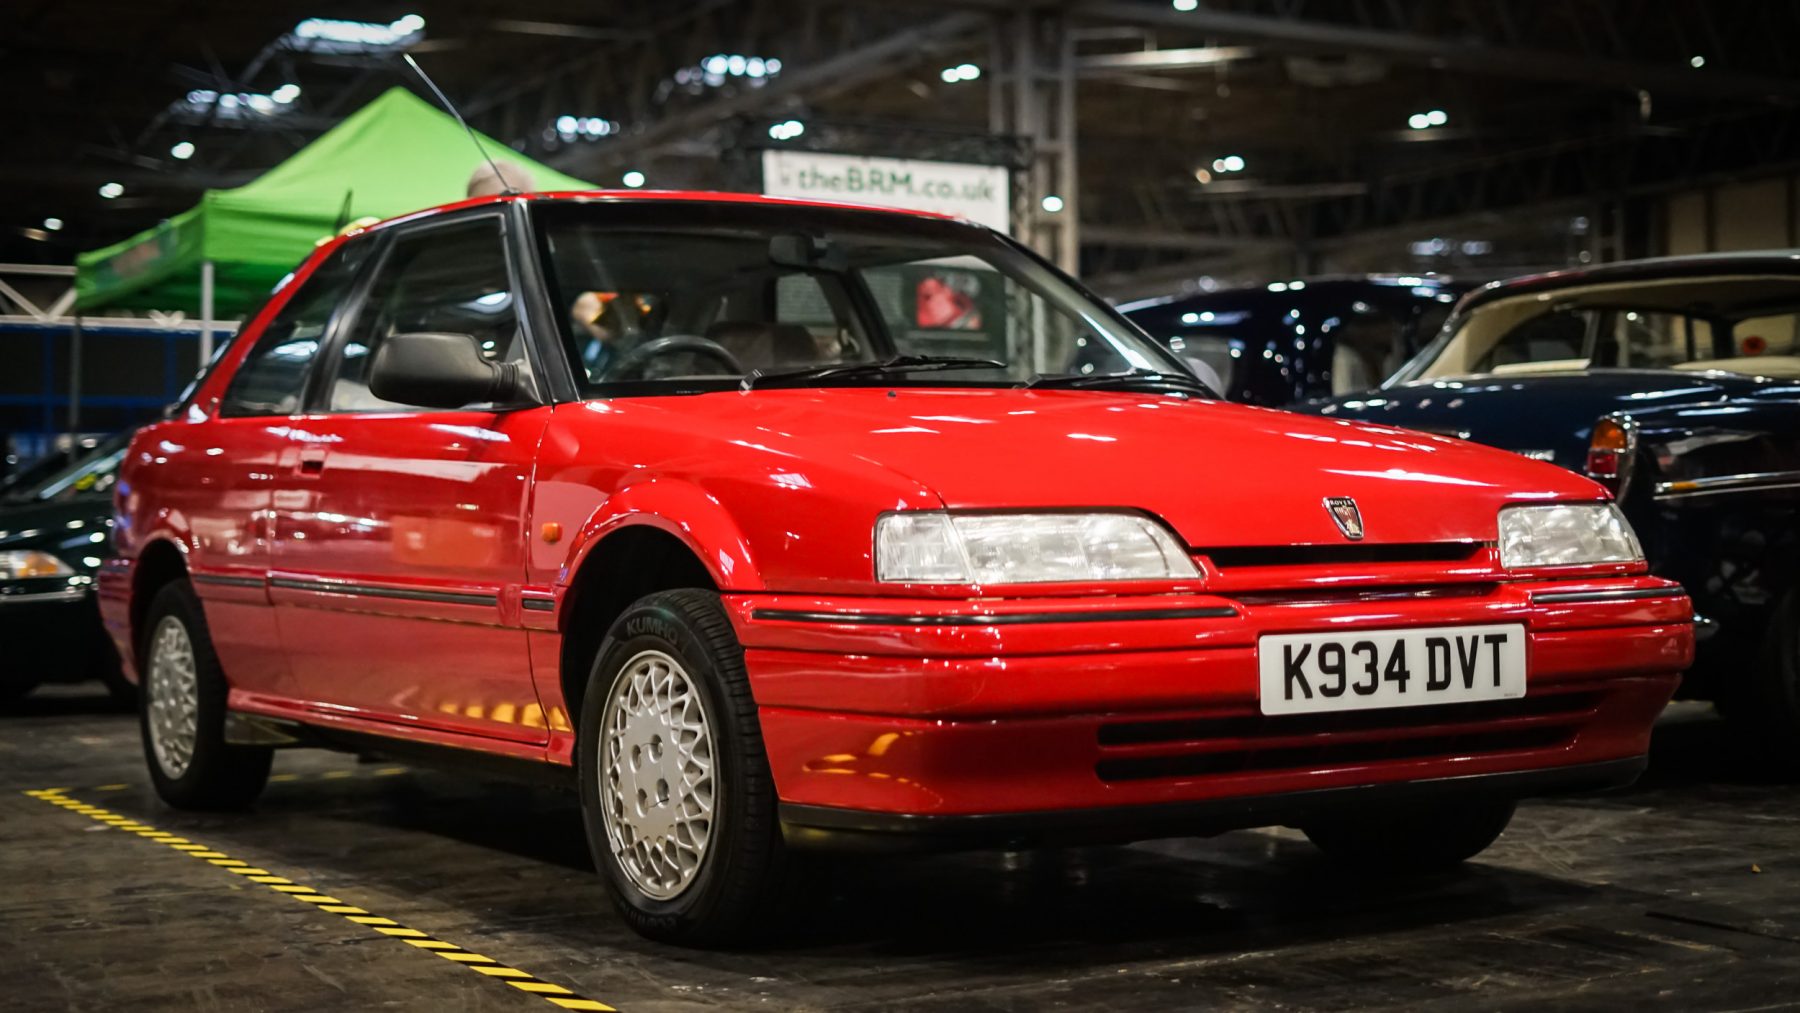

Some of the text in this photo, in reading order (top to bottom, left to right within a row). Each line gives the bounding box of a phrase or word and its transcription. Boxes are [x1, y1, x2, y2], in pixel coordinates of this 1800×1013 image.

[798, 167, 994, 200] theBRM.co.uk
[627, 616, 679, 645] KUMHO
[1283, 633, 1508, 700] K934 DVT
